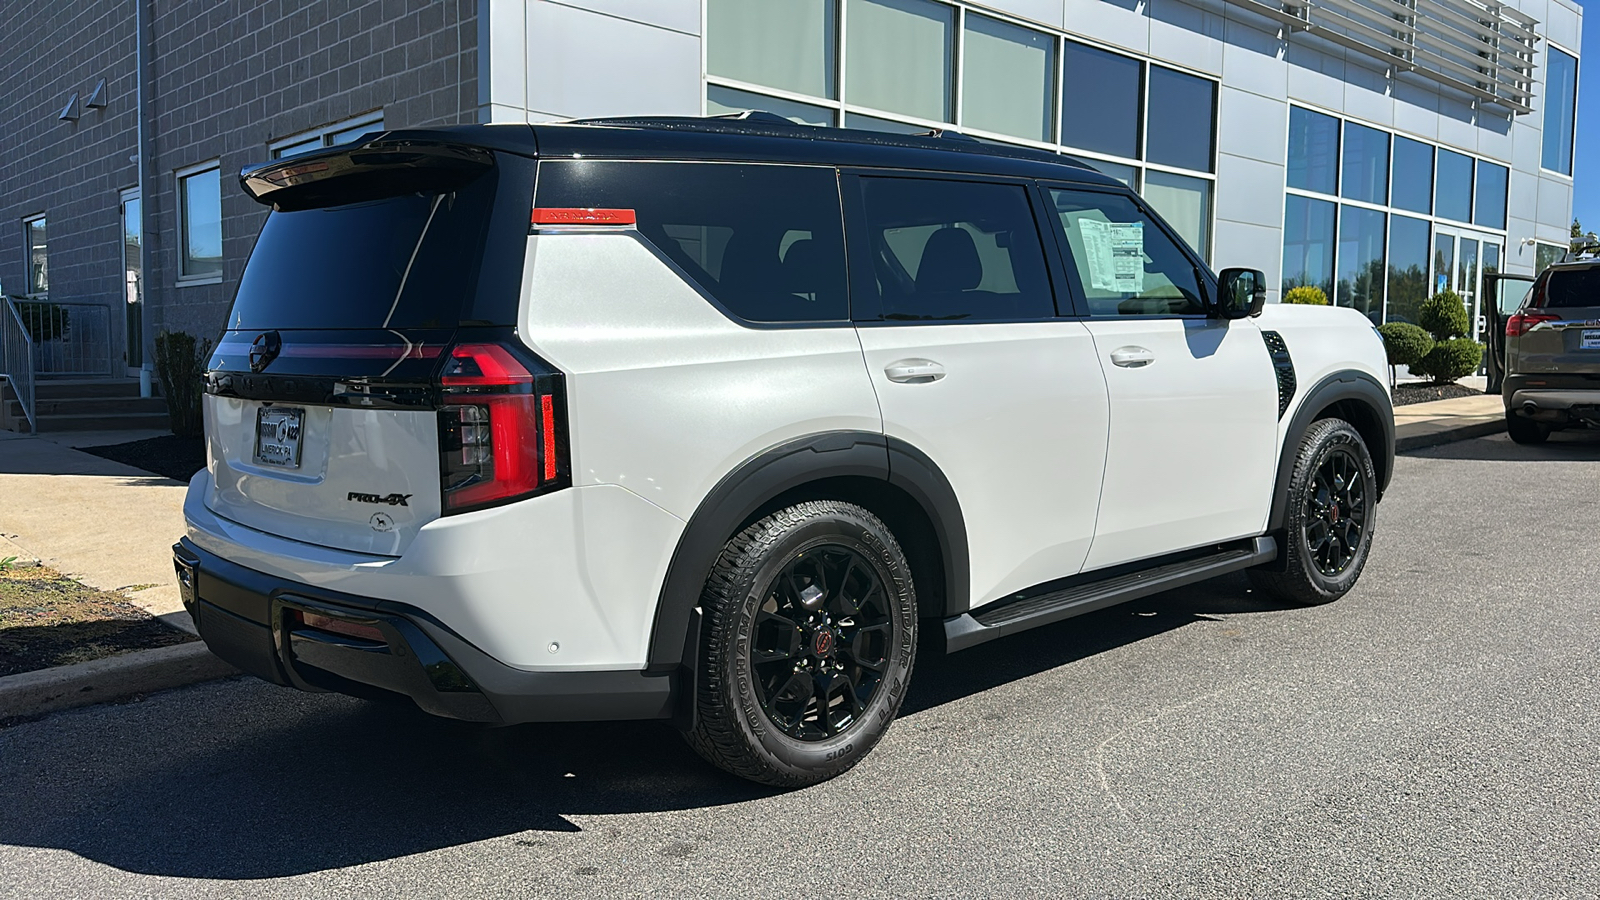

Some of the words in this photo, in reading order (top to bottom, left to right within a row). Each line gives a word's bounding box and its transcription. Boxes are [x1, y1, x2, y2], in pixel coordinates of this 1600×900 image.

[347, 492, 413, 507] PRO-4X
[861, 530, 913, 669] GEOLANDAR
[737, 596, 767, 742] YOKOHAMA
[826, 743, 856, 762] G015
